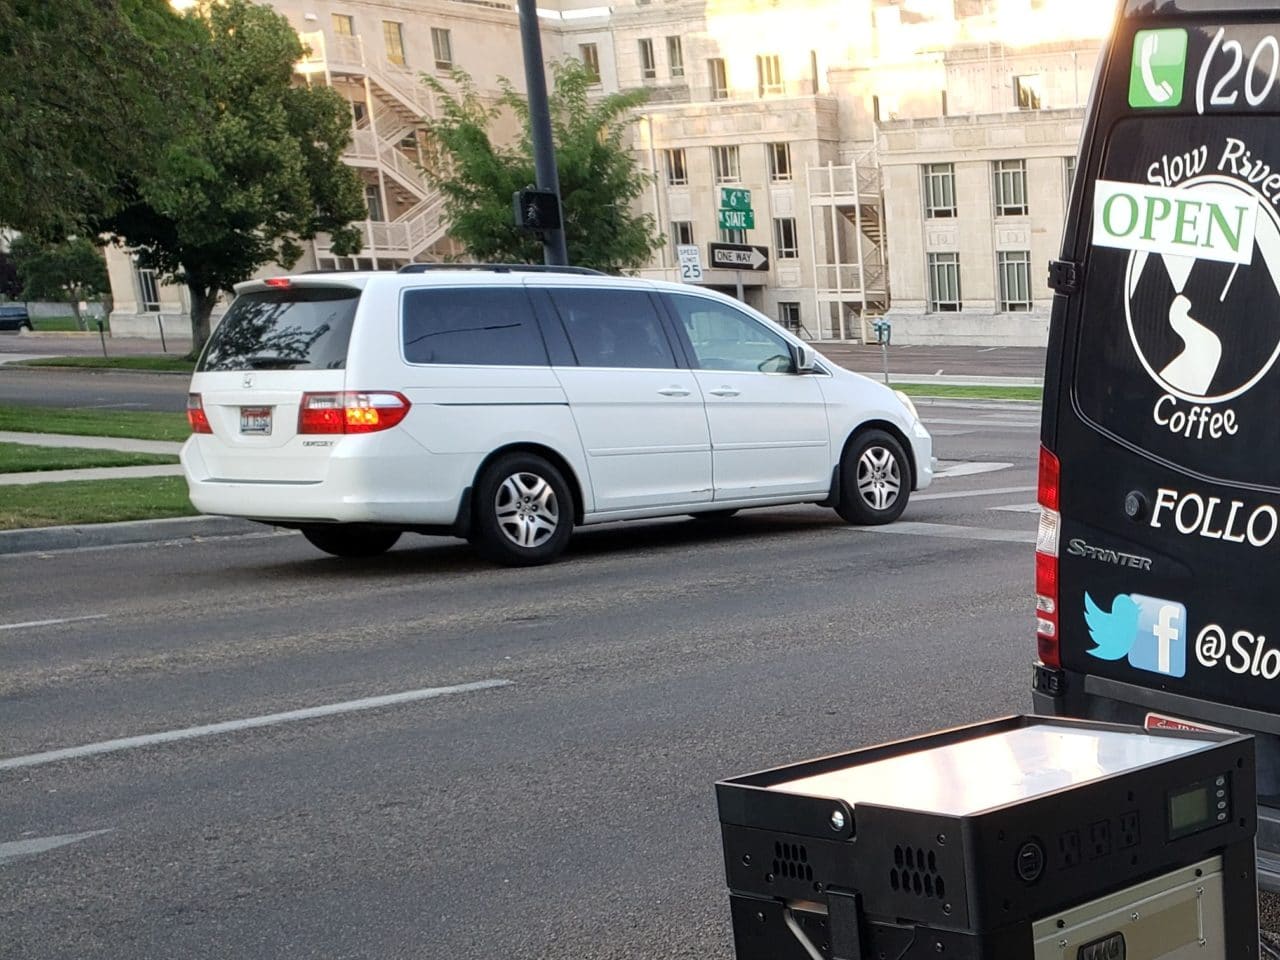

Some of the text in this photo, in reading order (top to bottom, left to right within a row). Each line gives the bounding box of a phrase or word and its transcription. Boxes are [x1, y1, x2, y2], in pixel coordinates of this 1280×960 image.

[1147, 144, 1208, 187] Slow
[725, 211, 747, 227] STATE
[1102, 193, 1249, 253] OPEN
[717, 251, 752, 262] ONE WAY
[682, 265, 701, 278] 25
[1153, 394, 1239, 440] Coffee
